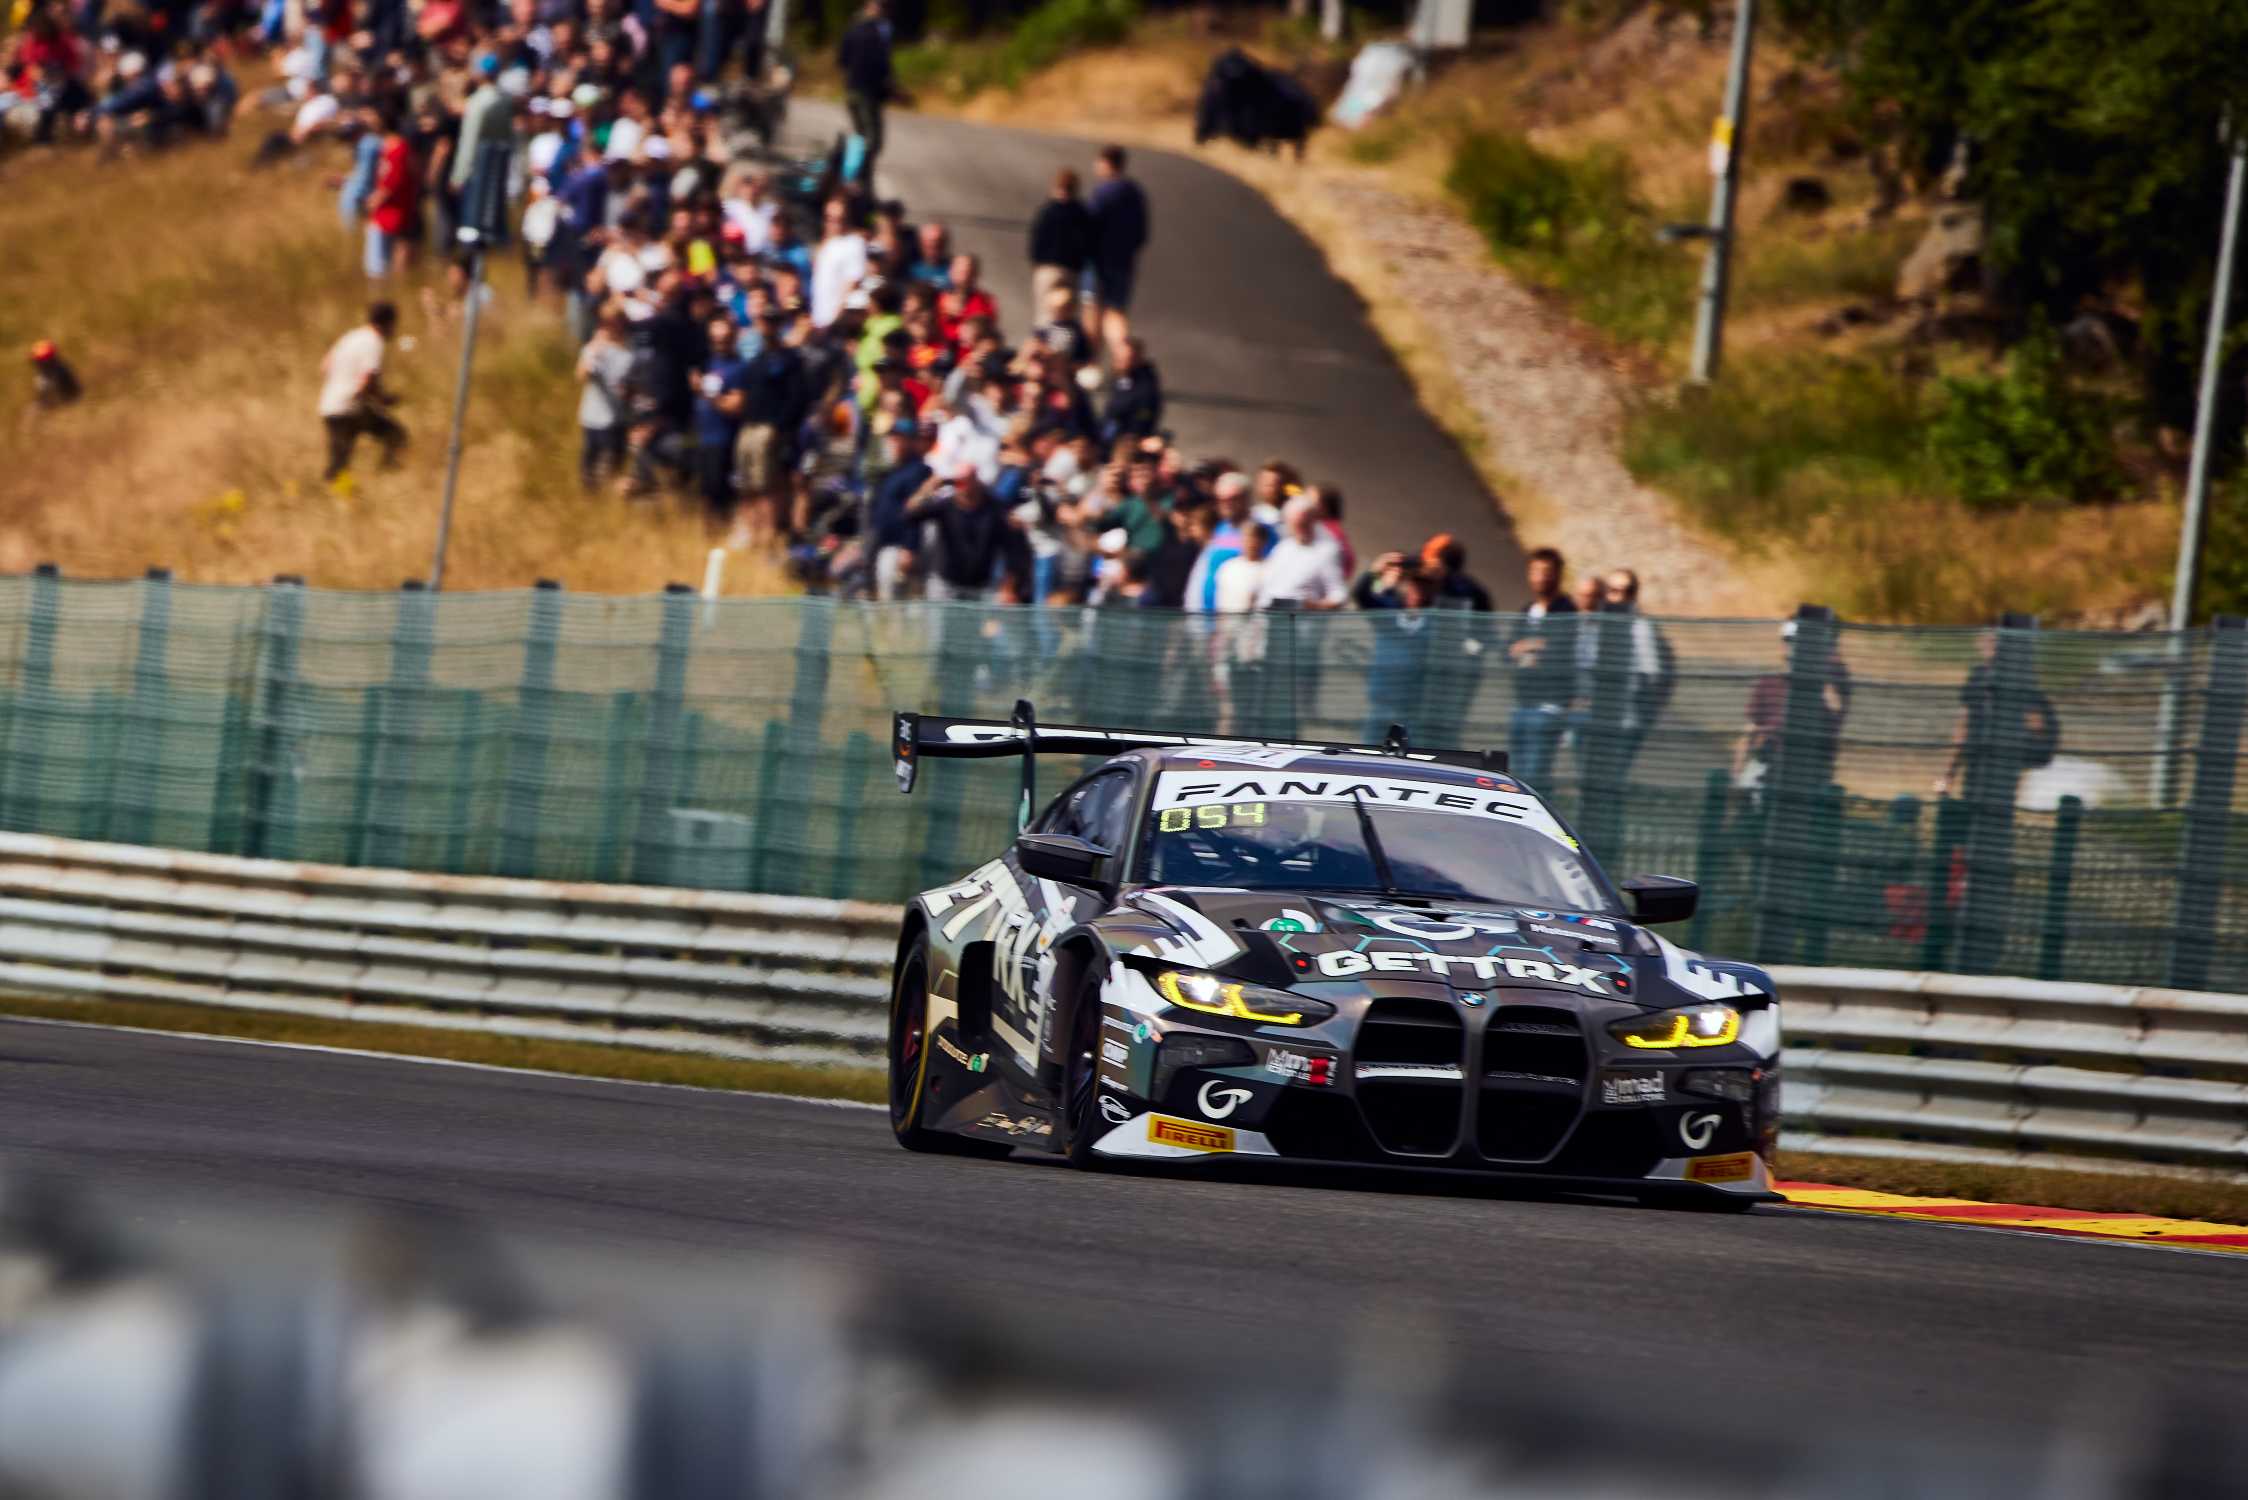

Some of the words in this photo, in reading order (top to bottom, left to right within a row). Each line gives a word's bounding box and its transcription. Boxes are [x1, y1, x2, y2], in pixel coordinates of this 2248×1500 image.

[1176, 780, 1530, 820] FANATEC
[1160, 803, 1265, 833] 054
[1156, 1120, 1229, 1151] PIRELLI
